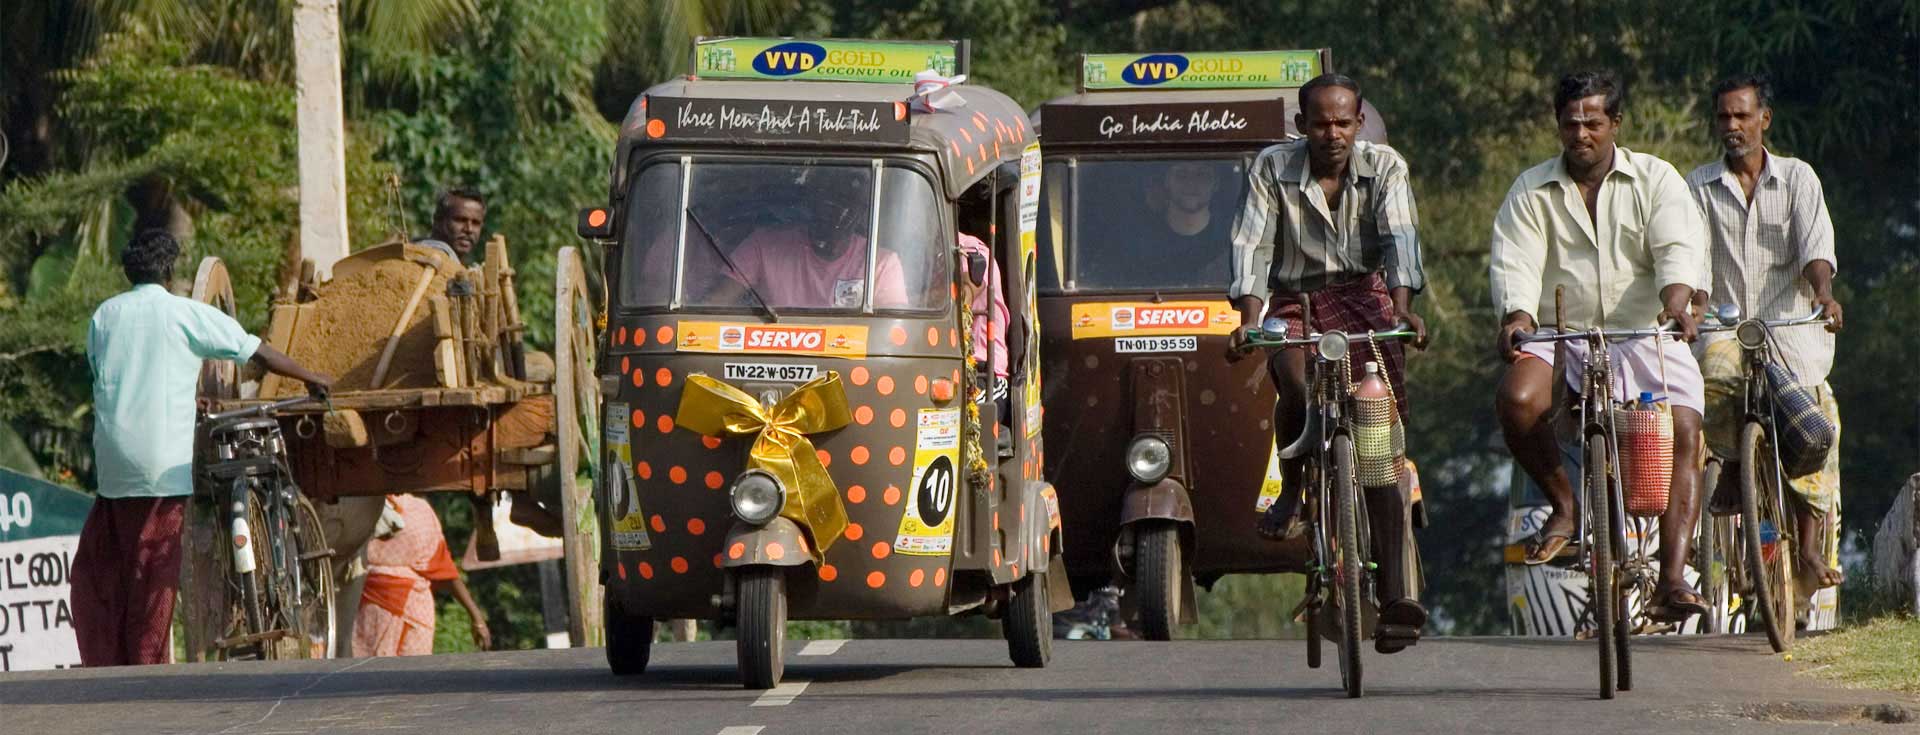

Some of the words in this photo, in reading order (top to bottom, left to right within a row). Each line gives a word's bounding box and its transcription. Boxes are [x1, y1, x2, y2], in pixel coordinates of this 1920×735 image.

[765, 51, 815, 70] VVD
[828, 50, 886, 67] GOLD
[1133, 62, 1179, 80] VVD
[1191, 58, 1244, 73] GOLD
[816, 66, 886, 77] COCONUT
[890, 69, 913, 78] OIL
[1180, 74, 1244, 82] COCONUT
[1248, 73, 1270, 82] OIL
[720, 104, 755, 130] Men
[758, 104, 795, 132] And
[798, 106, 810, 134] A
[1100, 115, 1123, 139] Go
[1132, 112, 1183, 135] India
[1187, 109, 1248, 134] Abolic
[1138, 309, 1205, 325] SERVO
[748, 330, 821, 349] SERVO
[925, 468, 950, 513] 10
